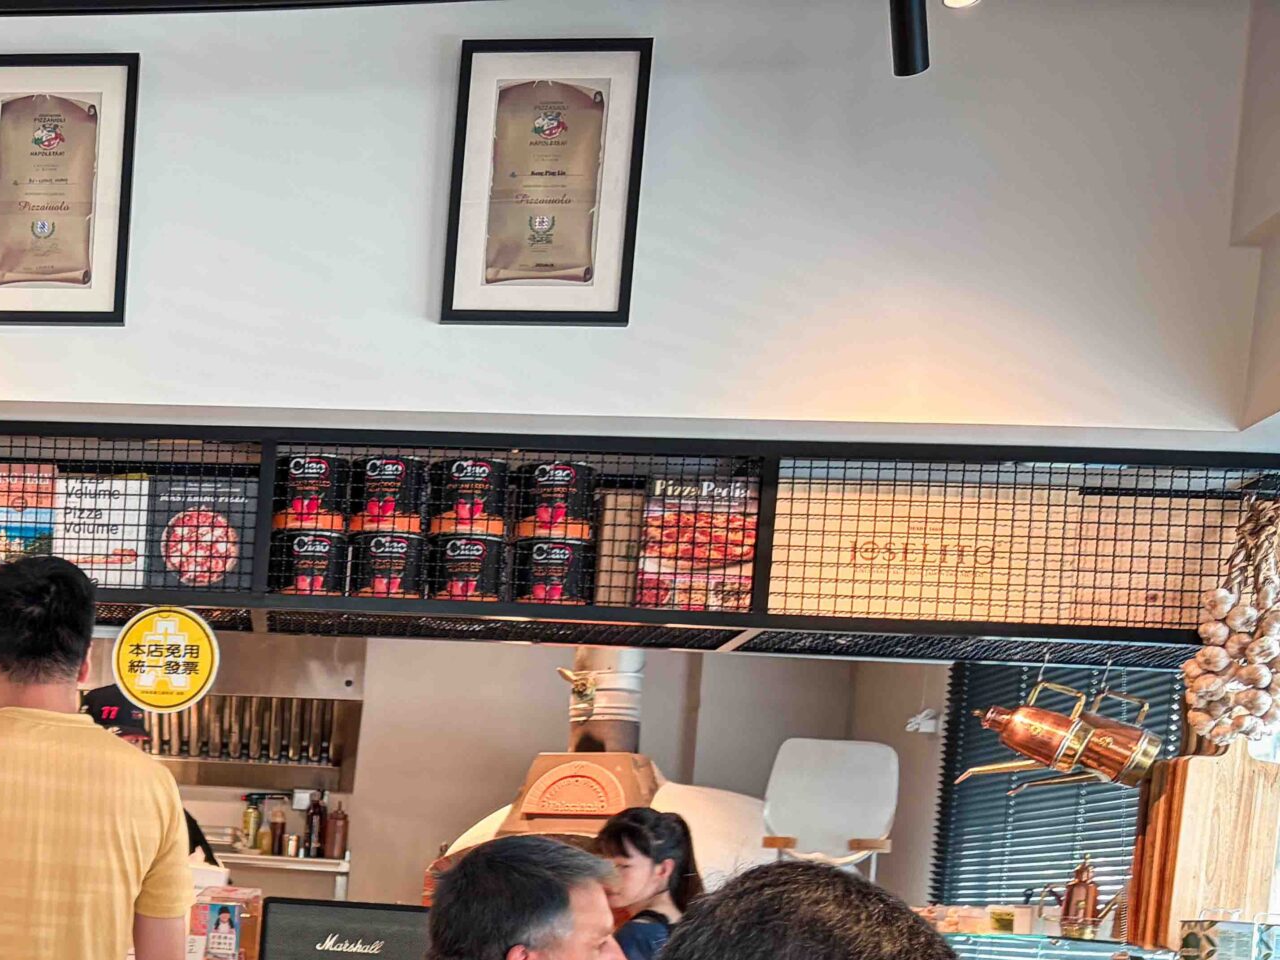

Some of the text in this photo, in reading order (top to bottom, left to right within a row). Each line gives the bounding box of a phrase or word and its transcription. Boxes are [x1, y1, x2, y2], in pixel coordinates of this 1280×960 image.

[65, 486, 121, 500] Volume
[64, 506, 103, 519] Pizza
[64, 521, 119, 535] Volume
[128, 643, 200, 659] 本店免用
[128, 659, 200, 675] 統一發票
[315, 933, 385, 954] Marshall
